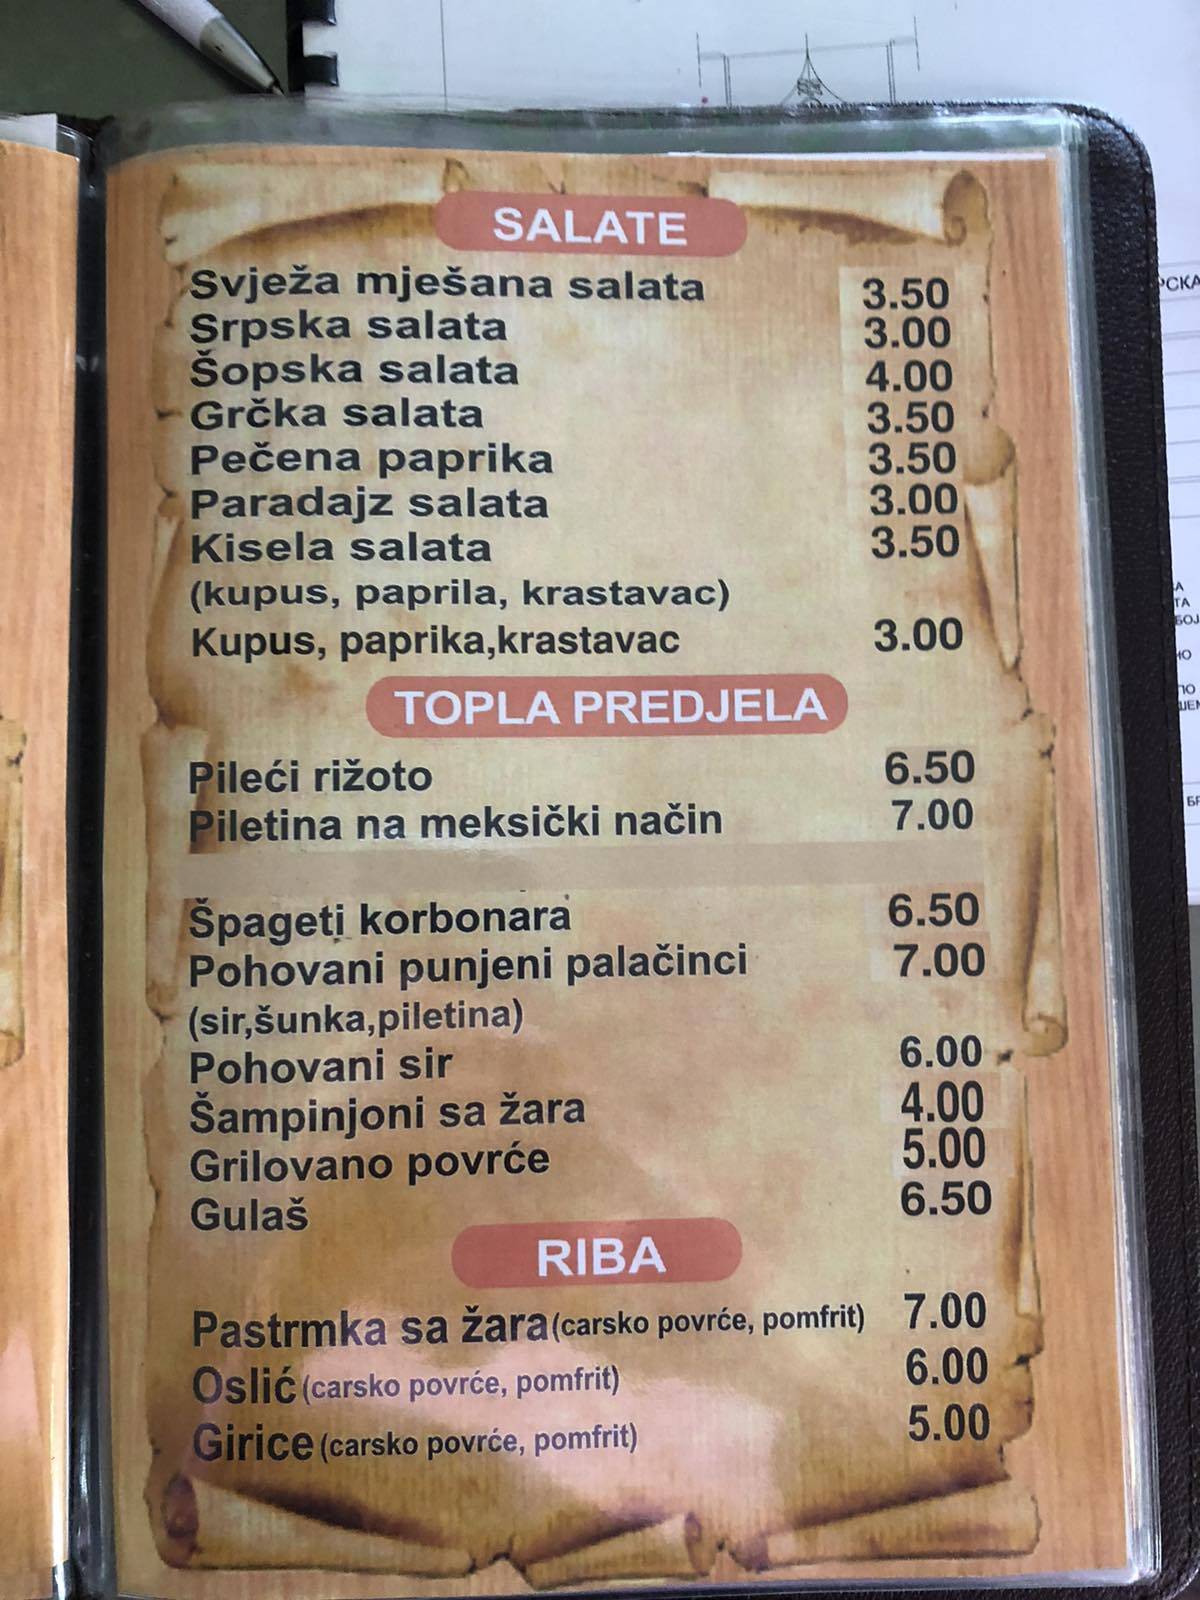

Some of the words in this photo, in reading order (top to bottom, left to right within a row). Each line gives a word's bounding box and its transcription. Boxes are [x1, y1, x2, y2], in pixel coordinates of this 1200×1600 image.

[493, 208, 687, 246] SALATE
[190, 266, 339, 303] Svježa
[357, 266, 553, 303] mješana
[569, 270, 705, 301] salata
[862, 277, 950, 310] 3.50
[190, 310, 351, 347] Srpska
[368, 310, 507, 341] salata
[864, 316, 952, 349] 3.00
[190, 350, 362, 391] Šopska
[379, 354, 519, 385] salata
[866, 359, 954, 393] 4.00
[190, 398, 327, 430] Grčka
[343, 398, 483, 428] salata
[867, 400, 955, 434] 3.50
[191, 443, 361, 475] Pečena
[379, 443, 553, 479] paprika
[868, 441, 957, 475] 3.50
[191, 487, 393, 524] Paradajz
[409, 488, 549, 518] salata
[869, 483, 959, 516] 3.00
[191, 533, 334, 564] Kisela
[350, 533, 492, 562] salata
[871, 525, 960, 559] 3.50
[190, 580, 339, 612] (kupus,
[356, 579, 508, 610] paprila,
[523, 578, 730, 611] krastavac)
[192, 627, 326, 663] Kupus,
[874, 617, 964, 652] 3.00
[394, 690, 561, 725] TOPLA
[574, 686, 829, 724] PREDJELA
[189, 759, 298, 794] Pileći
[315, 760, 432, 792] rižoto
[885, 750, 975, 785] 6.50
[189, 808, 342, 843] Piletina
[357, 813, 405, 840] na
[421, 805, 600, 839] meksički
[615, 803, 723, 835] način
[891, 798, 973, 831] 7.00
[189, 898, 345, 945] Špageti
[360, 902, 571, 935] korbonara
[889, 892, 980, 927] 6.50
[189, 952, 384, 987] Pohovani
[400, 947, 552, 990] punjeni
[567, 943, 747, 984] palačinci
[893, 943, 985, 977] 7.00
[190, 1047, 384, 1084] Pohovani
[399, 1047, 453, 1078] sir
[900, 1035, 982, 1068] 6.00
[190, 1092, 425, 1140] Šampinjoni
[439, 1101, 486, 1127] sa
[500, 1092, 585, 1125] žara
[901, 1081, 984, 1122] 4.00
[191, 1148, 392, 1183] Grilovano
[409, 1142, 550, 1184] povrće
[903, 1127, 986, 1169] 5.00
[191, 1196, 309, 1232] Gulaš
[901, 1180, 992, 1216] 6.50
[537, 1236, 666, 1276] RIBA
[192, 1310, 387, 1348] Pastrmka
[402, 1317, 448, 1345] sa
[462, 1305, 548, 1344] žara
[658, 1307, 755, 1338] povrće,
[763, 1303, 865, 1334] pomfrit)
[904, 1292, 987, 1330] 7.00
[192, 1365, 295, 1405] Oslić
[410, 1369, 507, 1402] povrće,
[516, 1365, 619, 1398] pomfrit)
[906, 1346, 988, 1386] 6.00
[192, 1423, 313, 1462] Girice
[427, 1428, 525, 1459] povrće,
[535, 1423, 638, 1456] pomfrit)
[908, 1403, 991, 1442] 5.00
